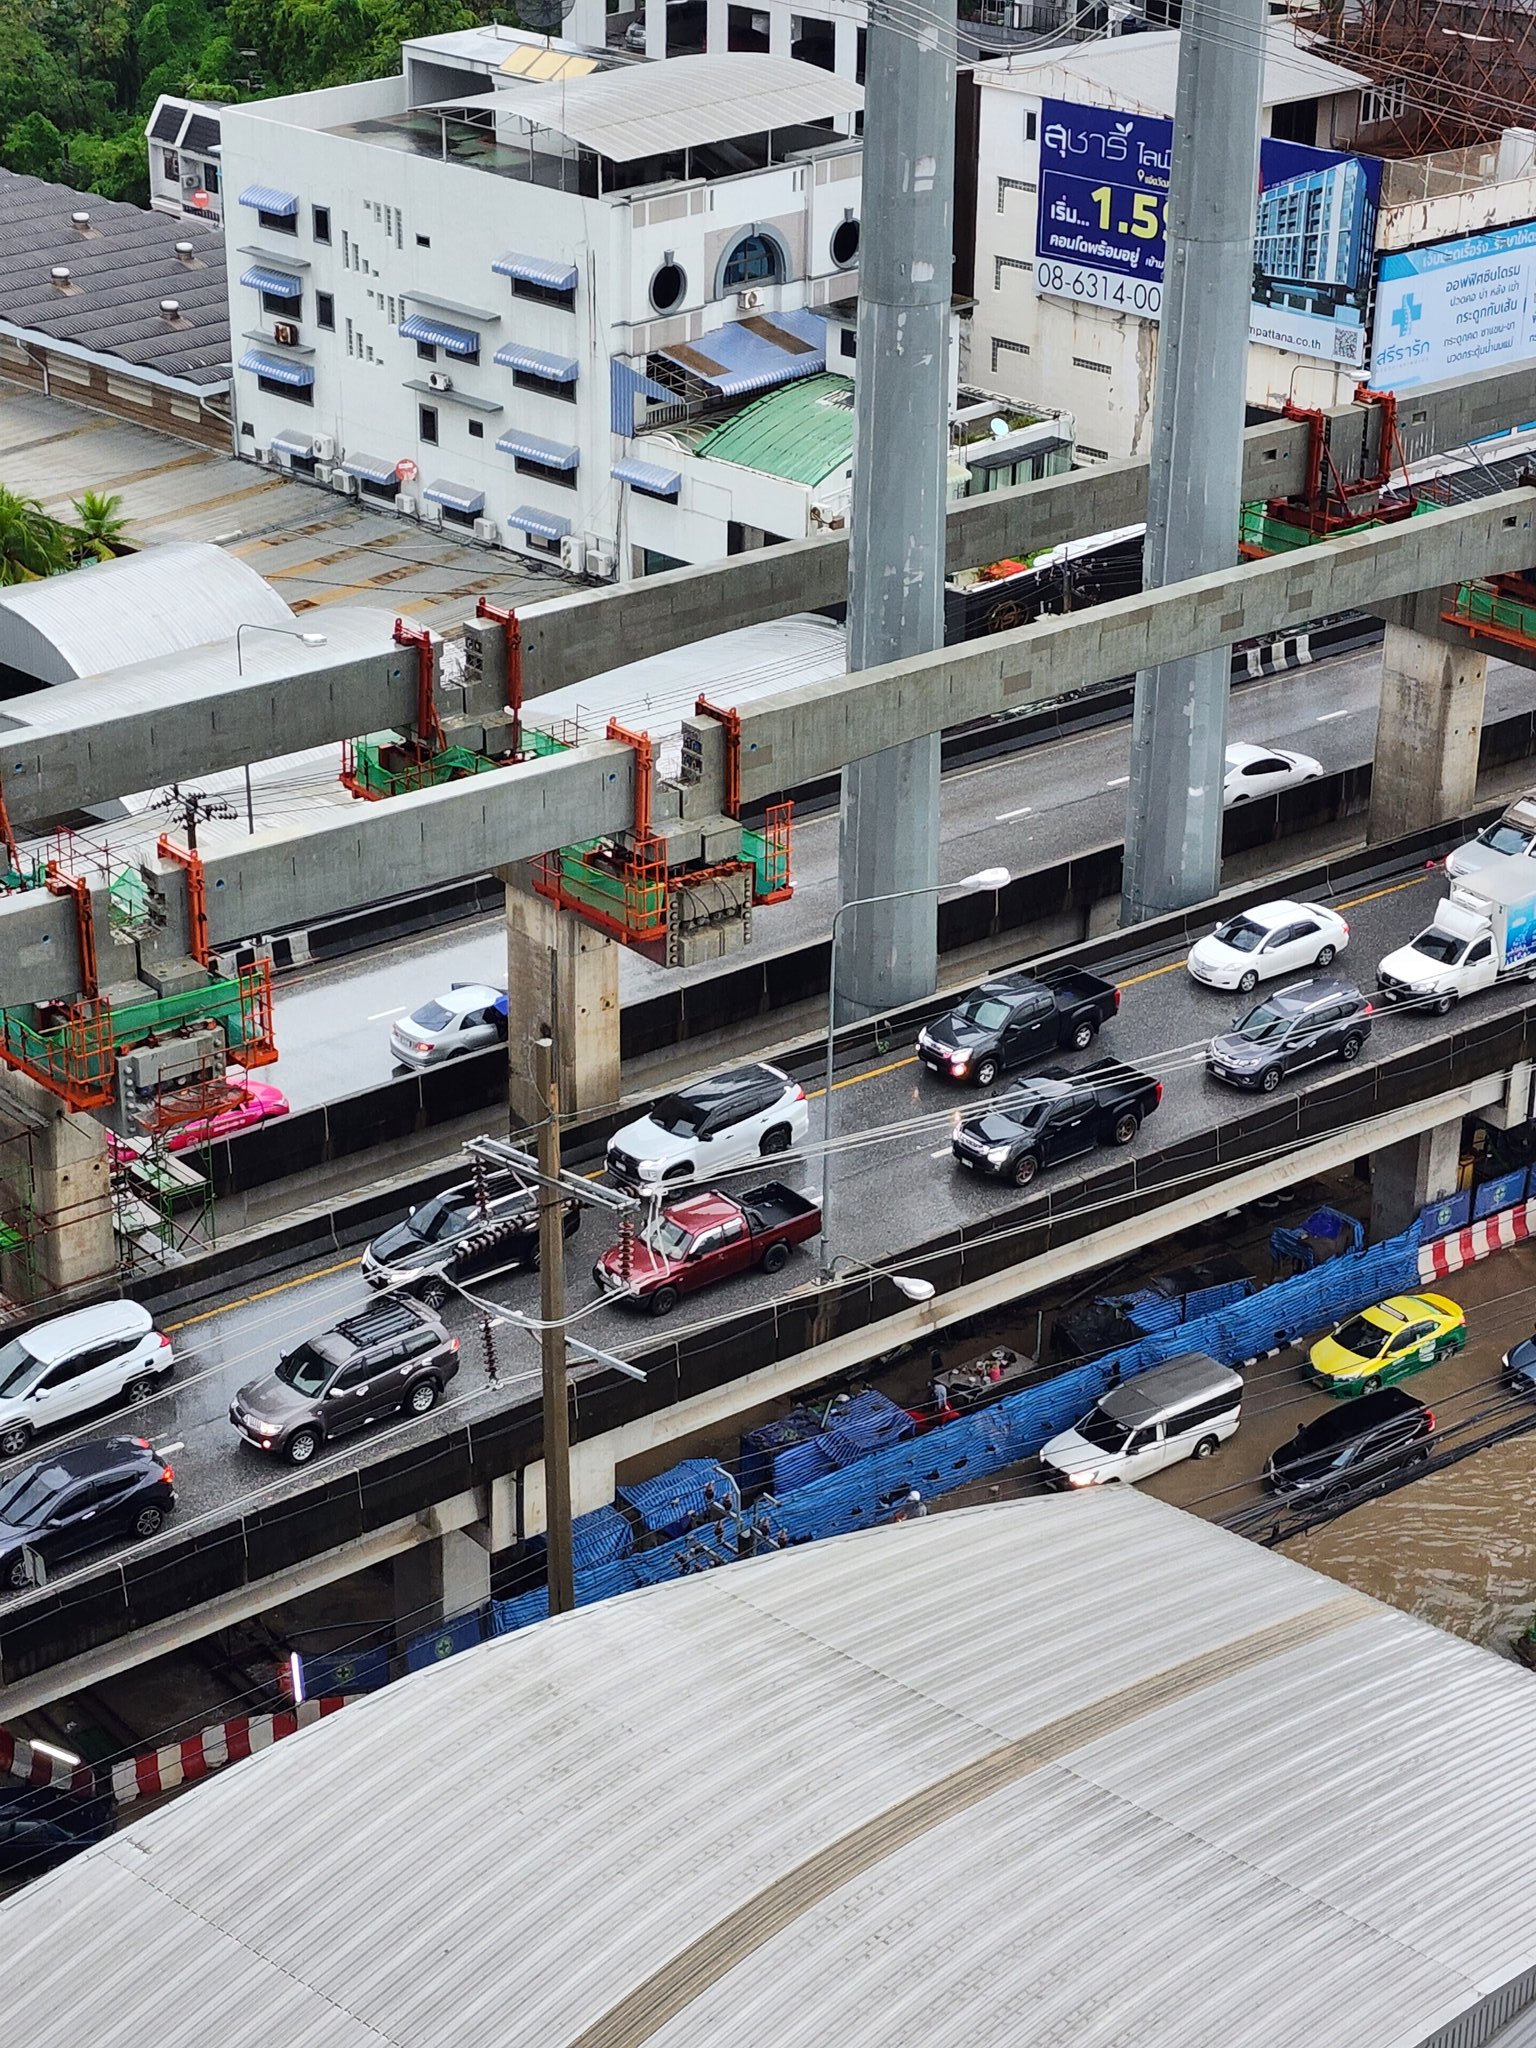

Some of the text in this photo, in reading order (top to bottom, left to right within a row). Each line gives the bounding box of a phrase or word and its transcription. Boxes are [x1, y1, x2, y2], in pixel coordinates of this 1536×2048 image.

[1049, 234, 1141, 269] คอนโดพร้อมอยู่
[1038, 262, 1161, 312] 08-6314-00
